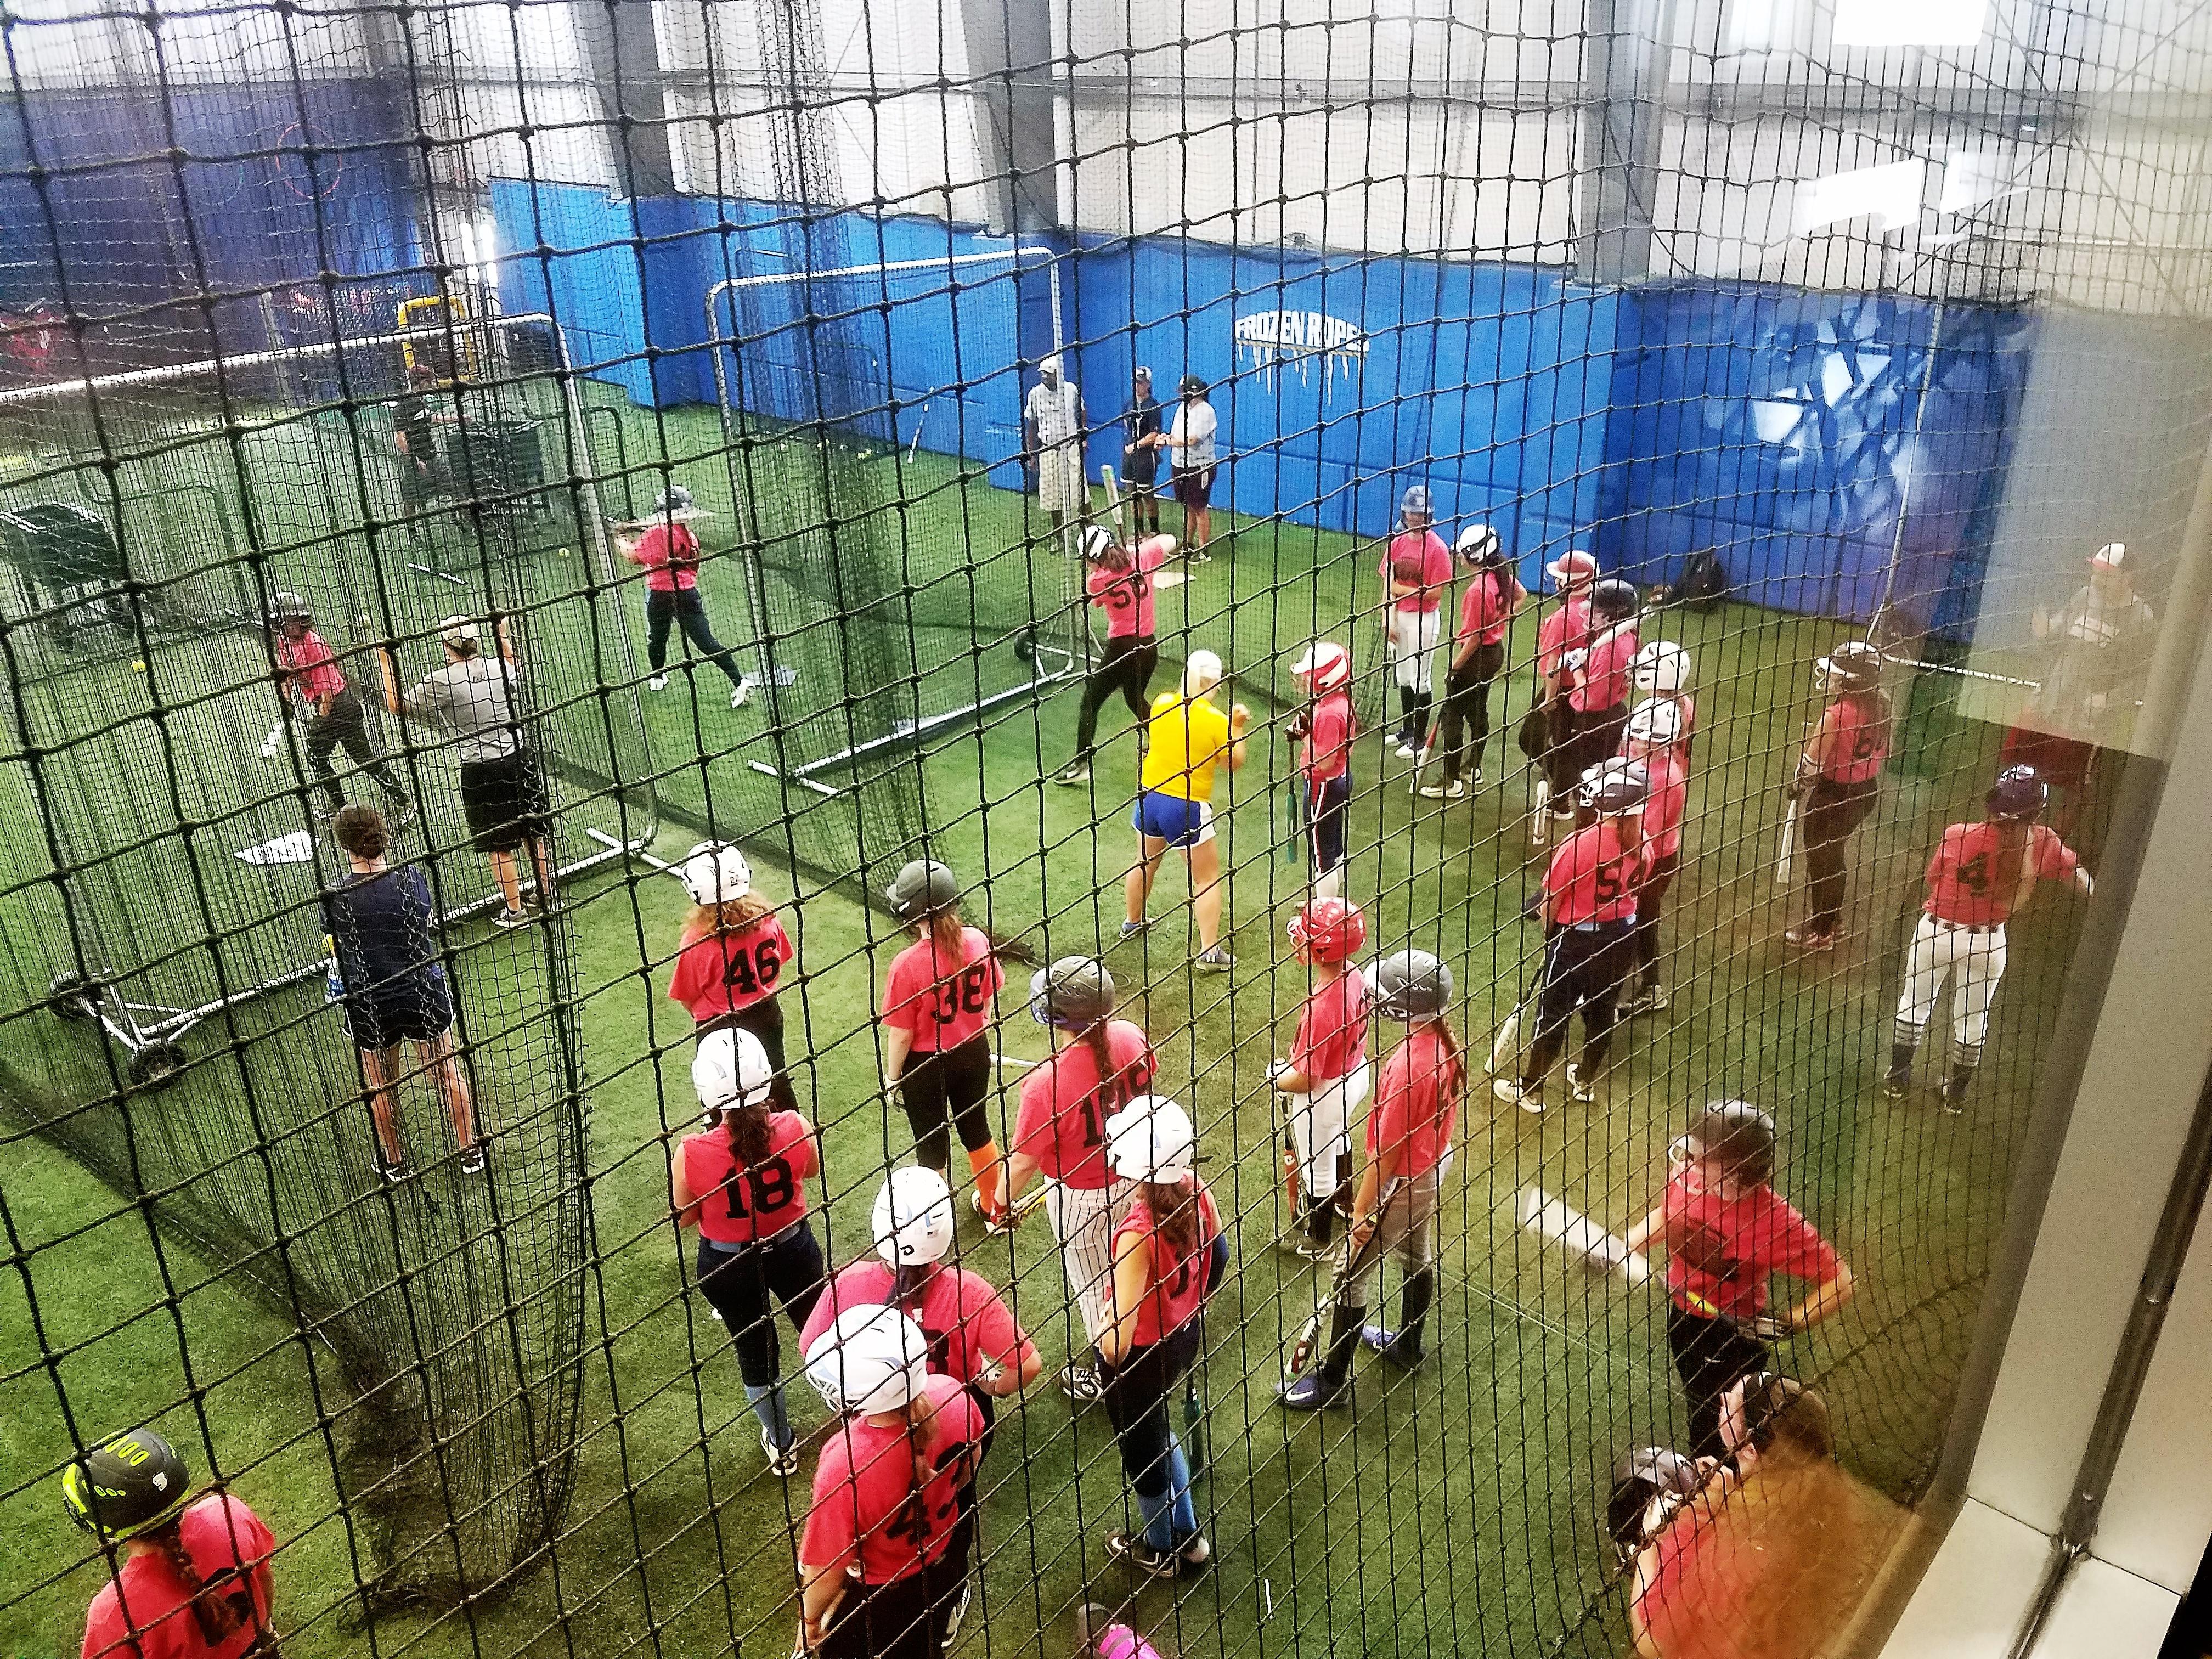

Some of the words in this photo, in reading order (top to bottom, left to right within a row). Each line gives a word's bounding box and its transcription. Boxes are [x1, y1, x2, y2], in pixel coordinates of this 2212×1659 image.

[1235, 310, 1305, 345] FROZEN
[723, 938, 780, 994] 46
[930, 964, 986, 1024] 38
[720, 1156, 793, 1219] 18
